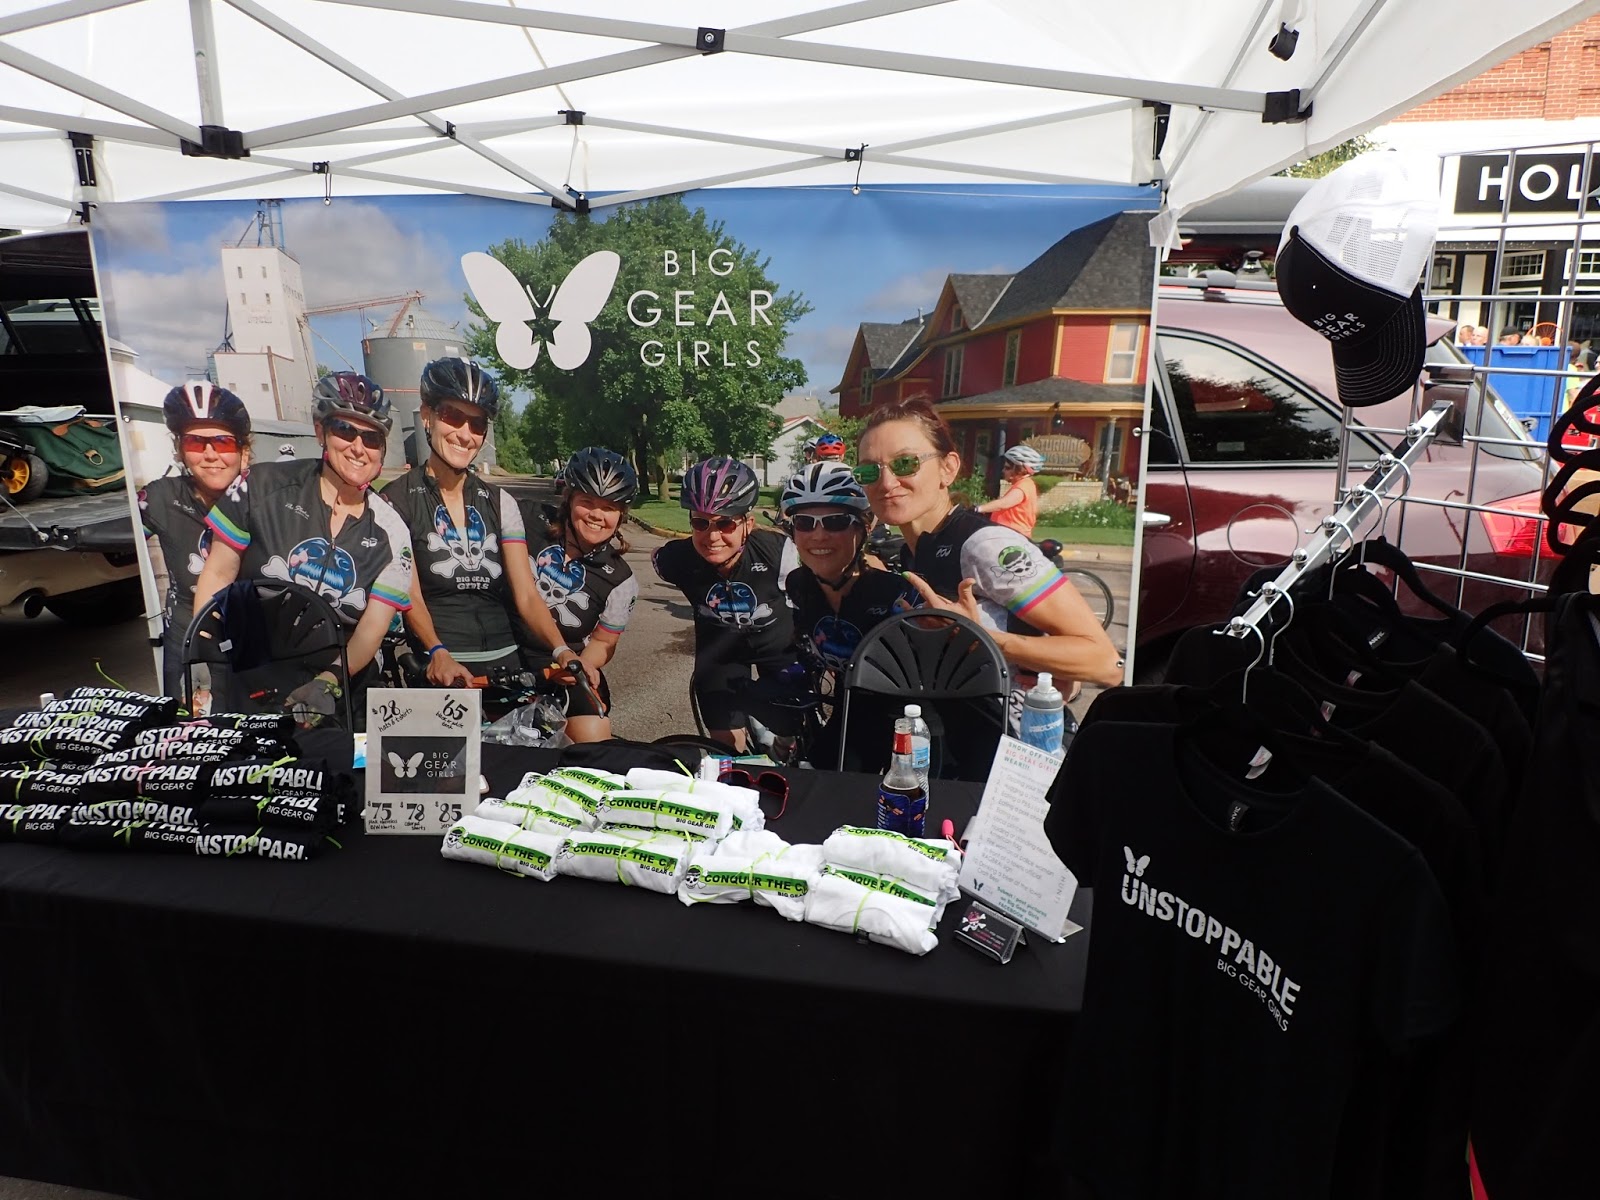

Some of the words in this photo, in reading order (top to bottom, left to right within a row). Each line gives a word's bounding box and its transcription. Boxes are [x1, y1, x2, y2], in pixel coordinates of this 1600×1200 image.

[665, 249, 735, 276] BIG
[627, 289, 773, 327] GEAR
[1313, 313, 1336, 327] BIG
[1331, 322, 1365, 340] GIRLS
[640, 340, 761, 367] GIRLS
[68, 743, 90, 753] GEAR
[1007, 742, 1027, 753] SHOW
[1028, 750, 1041, 759] OFF
[432, 751, 449, 759] BIG
[1005, 749, 1017, 757] BIG
[1018, 754, 1036, 765] GEAR
[424, 760, 458, 769] GEAR
[426, 770, 455, 778] GIRLS
[31, 783, 45, 791] BIG
[46, 784, 71, 794] GEAR
[145, 781, 159, 791] BIG
[159, 782, 185, 791] GEAR
[577, 793, 594, 808] THE
[266, 805, 279, 815] BIG
[280, 807, 302, 819] GEAR
[609, 799, 665, 812] CONQUER
[668, 805, 691, 818] THE
[25, 822, 39, 831] BIG
[687, 819, 704, 828] GEAR
[144, 831, 160, 841] BIG
[161, 832, 185, 843] GEAR
[513, 848, 530, 859] THE
[632, 851, 655, 864] THE
[650, 865, 668, 875] GEAR
[766, 879, 792, 891] THE
[997, 901, 1024, 918] FACEBOOK
[1121, 873, 1301, 1016] UNSTOPPABLE
[1217, 959, 1237, 978] BIG
[1238, 973, 1267, 1004] GEAR
[1267, 999, 1289, 1032] GIRLS
